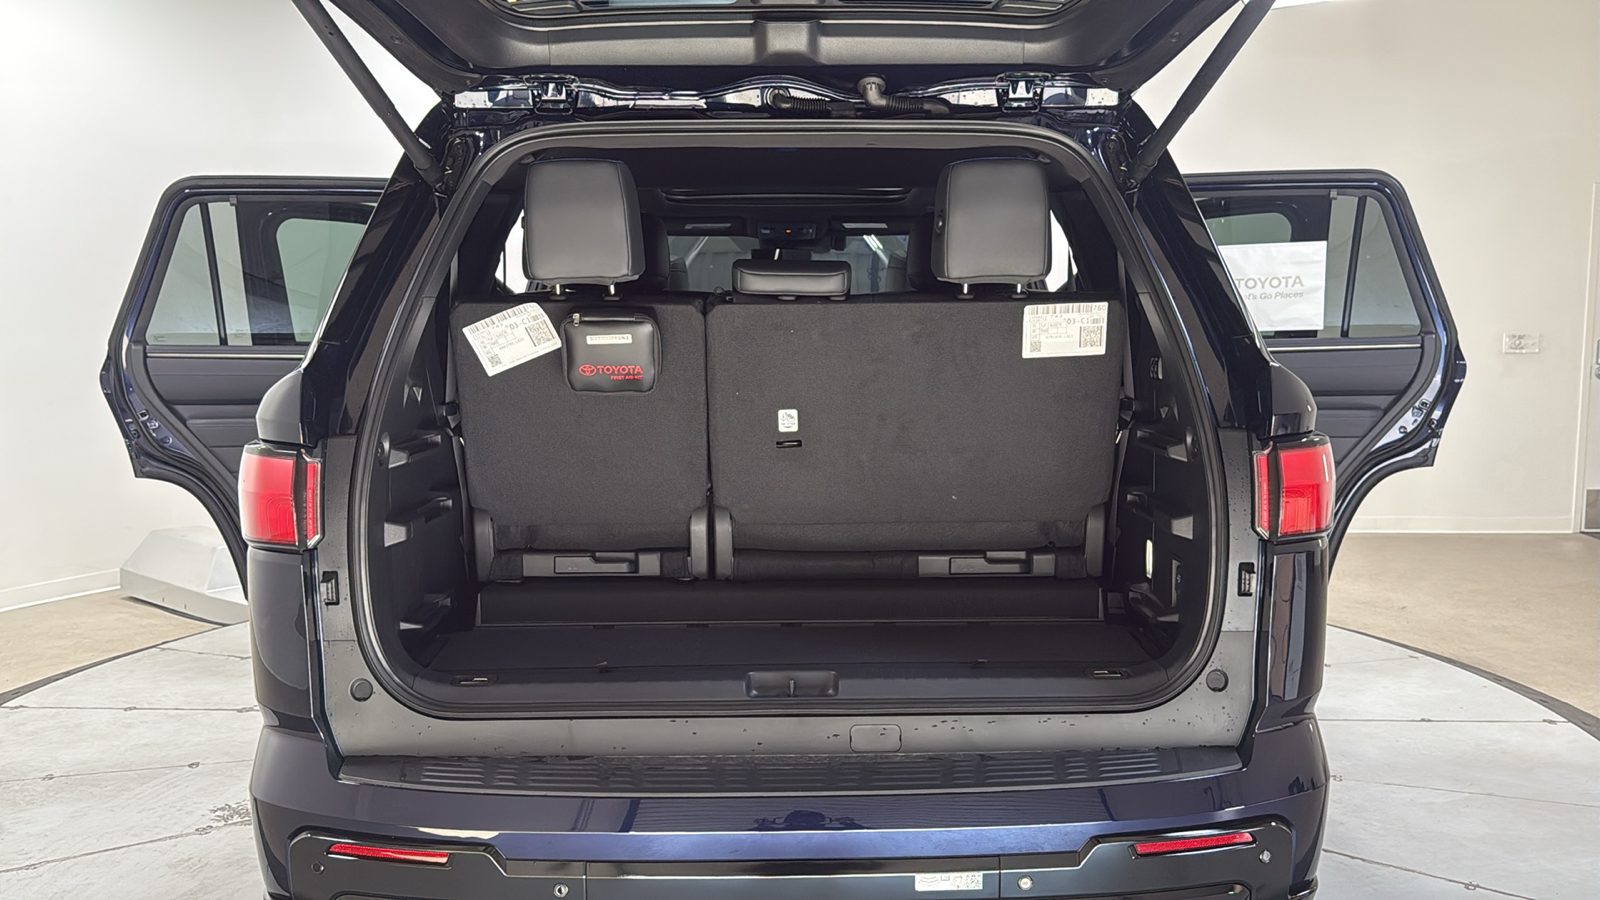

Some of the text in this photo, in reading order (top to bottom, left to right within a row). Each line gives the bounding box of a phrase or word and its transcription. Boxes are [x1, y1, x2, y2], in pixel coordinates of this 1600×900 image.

[1235, 276, 1304, 290] TOYOTA
[1260, 292, 1272, 300] Go
[1274, 291, 1304, 300] Places
[597, 365, 643, 374] TOYOTA
